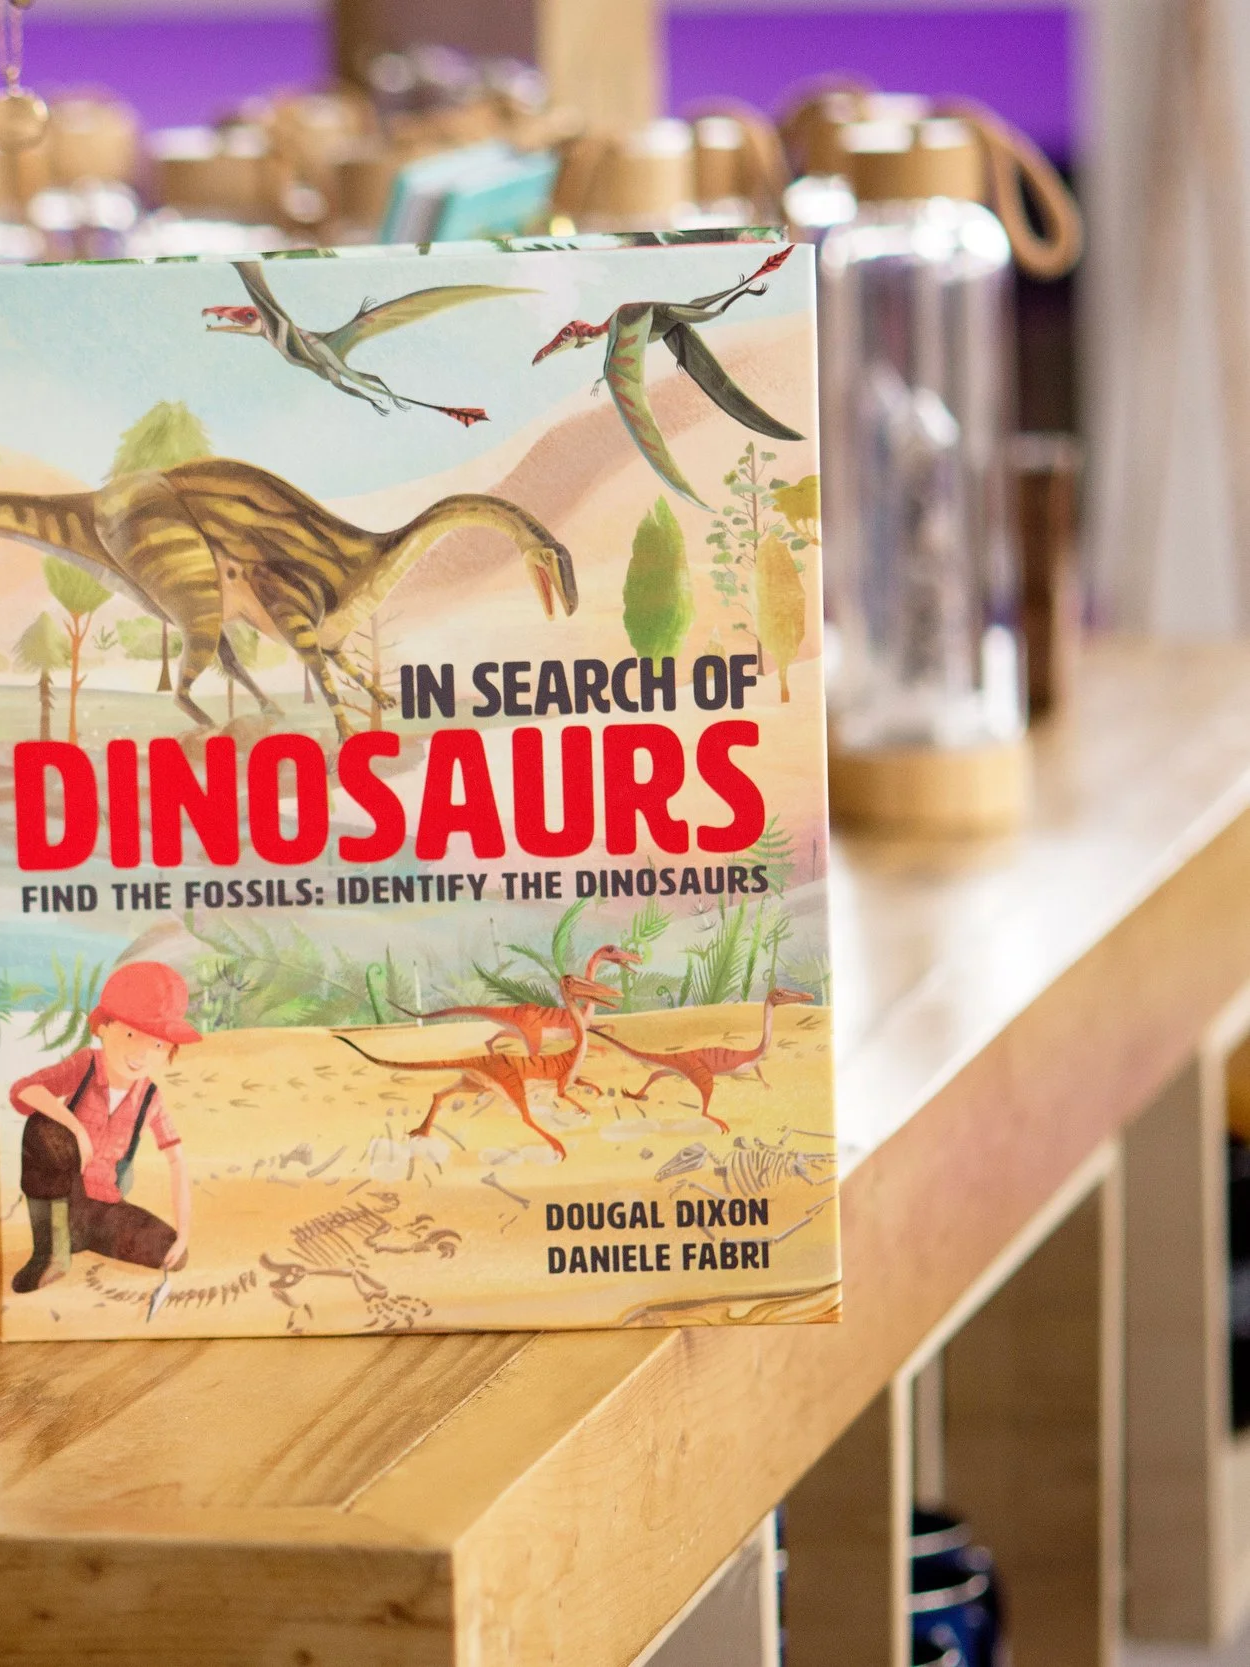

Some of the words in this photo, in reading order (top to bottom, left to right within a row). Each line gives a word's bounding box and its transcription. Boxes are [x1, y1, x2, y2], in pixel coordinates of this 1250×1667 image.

[401, 664, 456, 720] IN
[471, 657, 676, 718] SEARCH
[693, 654, 759, 712] OF
[12, 719, 768, 872] DINOSAURS
[21, 884, 99, 914] FIND
[114, 881, 173, 911] THE
[184, 877, 326, 909] FOSSILS:
[336, 873, 489, 906] IDENTIFY
[501, 870, 564, 902] THE
[575, 865, 770, 900] DINOSAURS
[546, 1200, 665, 1231] DOUGAL
[676, 1198, 770, 1229] DIXON
[548, 1243, 671, 1275] DANIELE
[682, 1240, 770, 1271] FABRI
